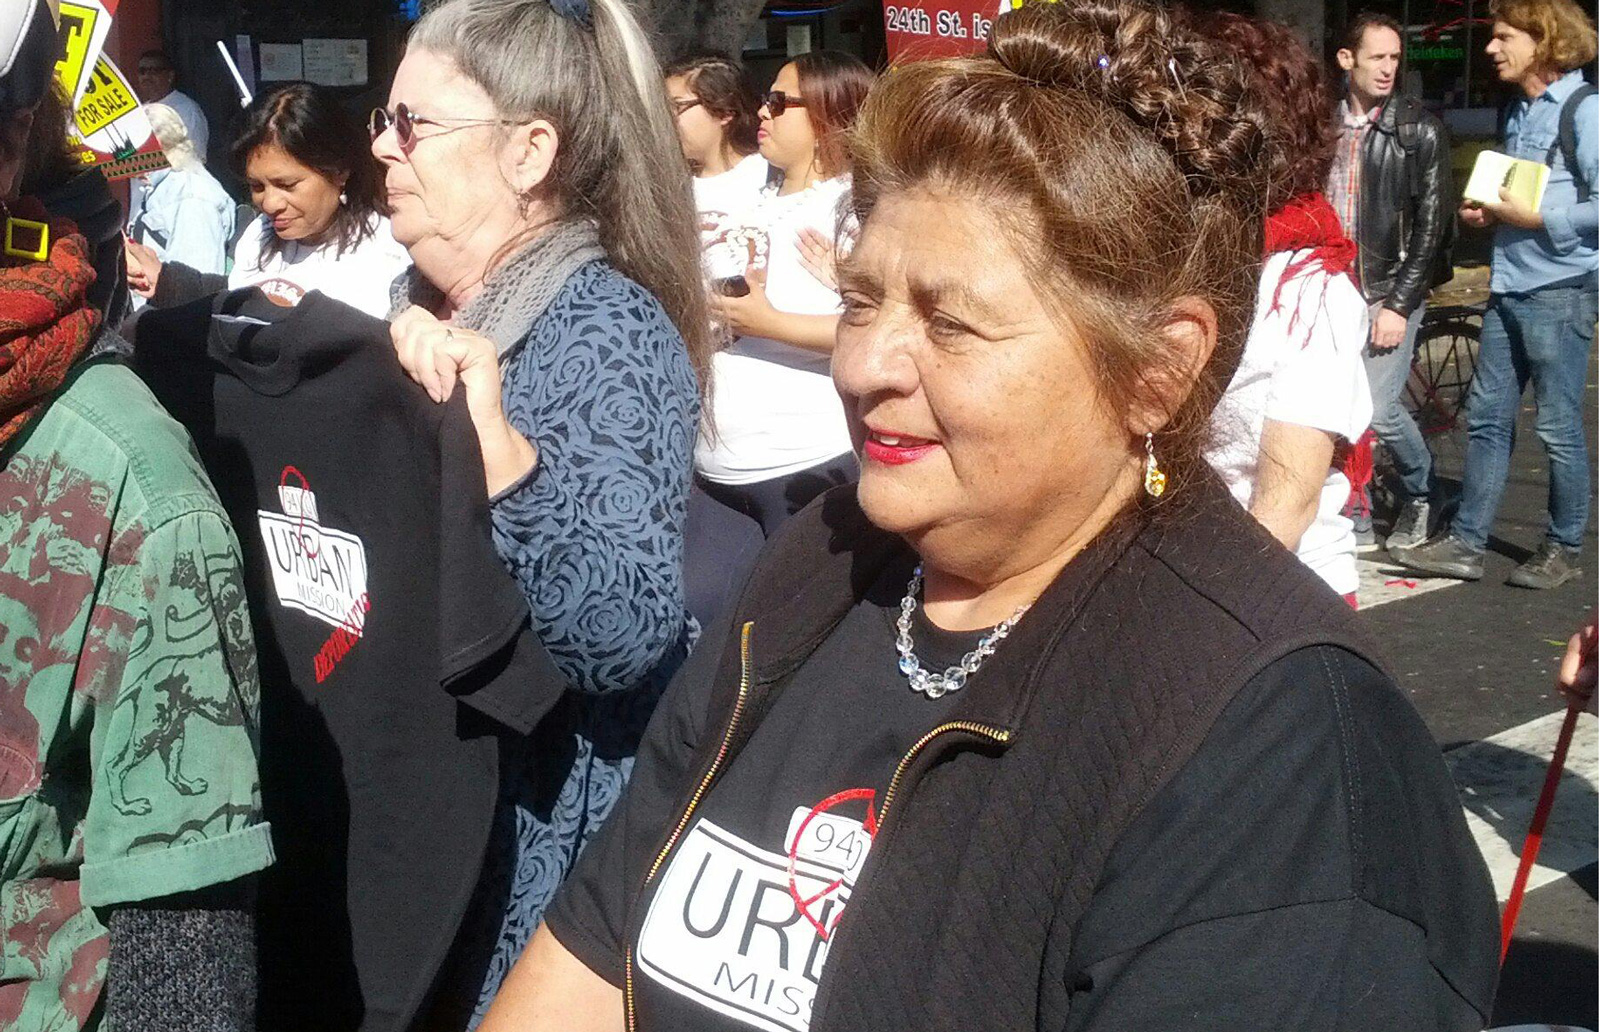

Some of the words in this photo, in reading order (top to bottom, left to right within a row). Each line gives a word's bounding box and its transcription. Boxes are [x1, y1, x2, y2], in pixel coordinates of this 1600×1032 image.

[887, 6, 931, 34] 24th
[937, 10, 967, 38] St.
[973, 13, 992, 40] is
[77, 102, 104, 128] FOR
[97, 88, 128, 116] SALE
[269, 526, 353, 599] URBAN
[297, 582, 345, 616] MISSION
